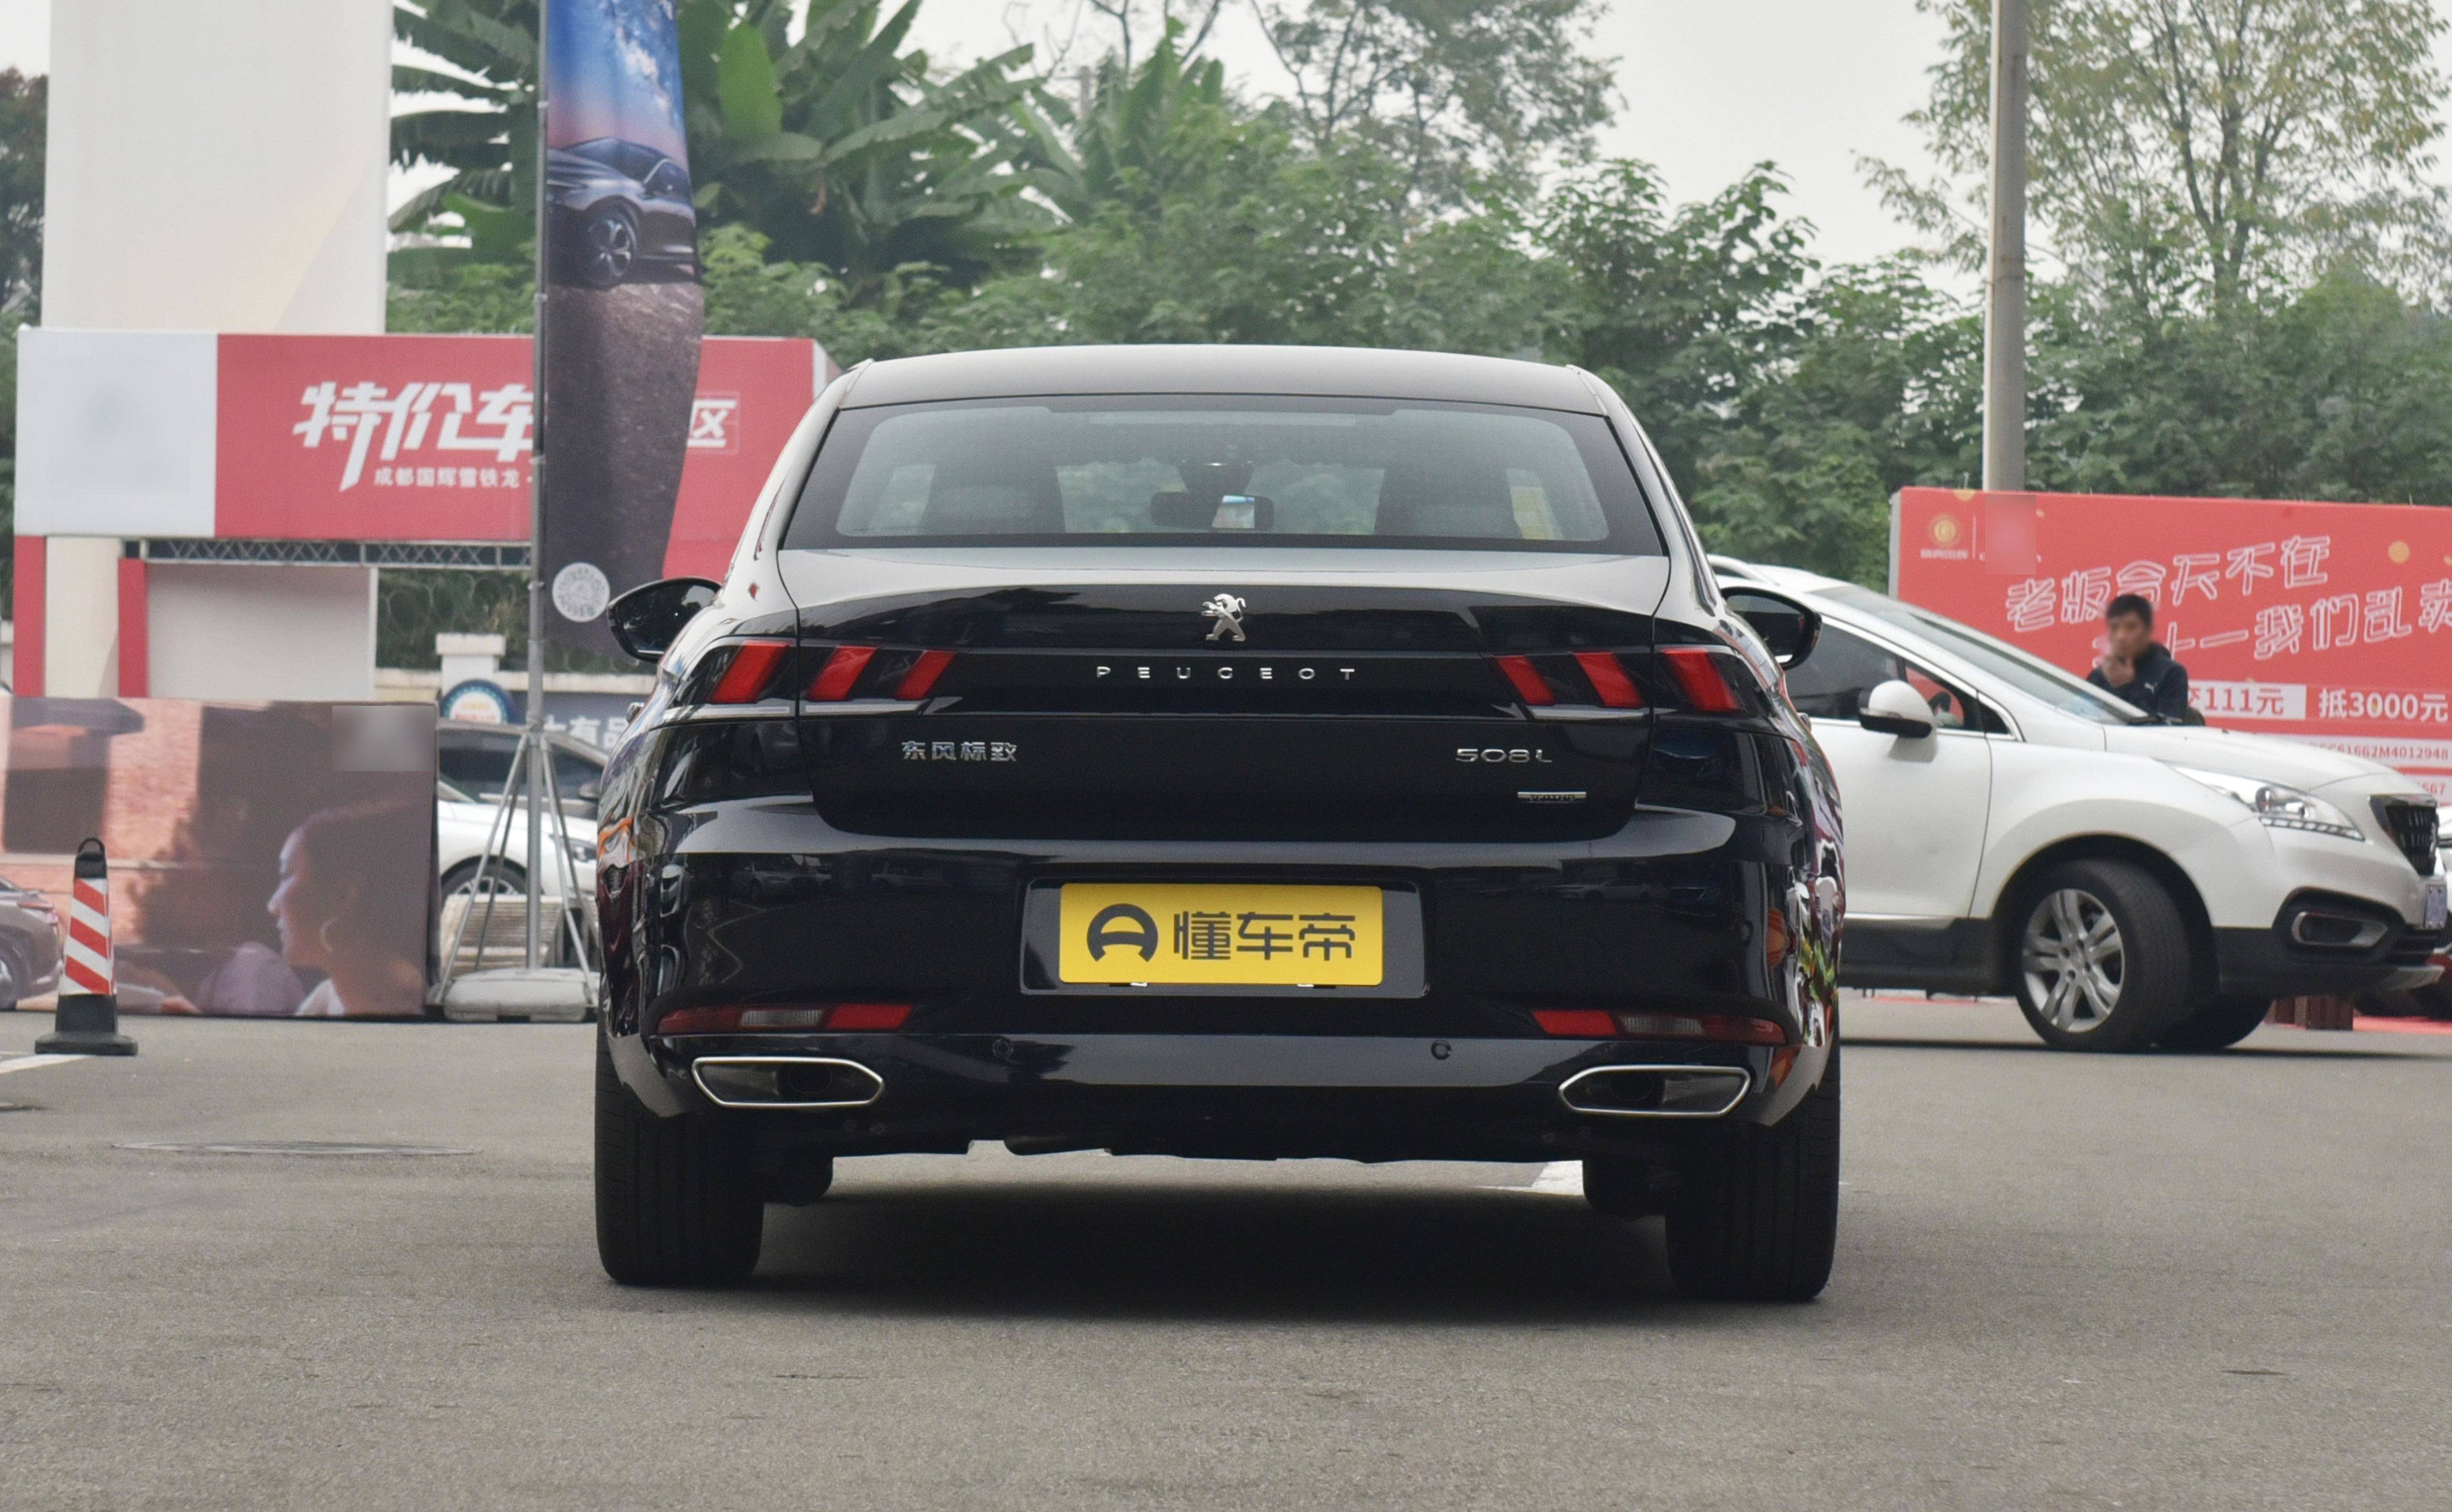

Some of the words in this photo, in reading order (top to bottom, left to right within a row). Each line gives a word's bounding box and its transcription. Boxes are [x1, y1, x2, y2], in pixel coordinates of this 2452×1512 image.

[1097, 666, 1355, 680] PEUGEOT
[2319, 688, 2449, 723] 抵3000元
[901, 741, 1017, 762] 东风标致
[1456, 749, 1552, 762] 508L
[1174, 911, 1355, 961] 懂车帝
